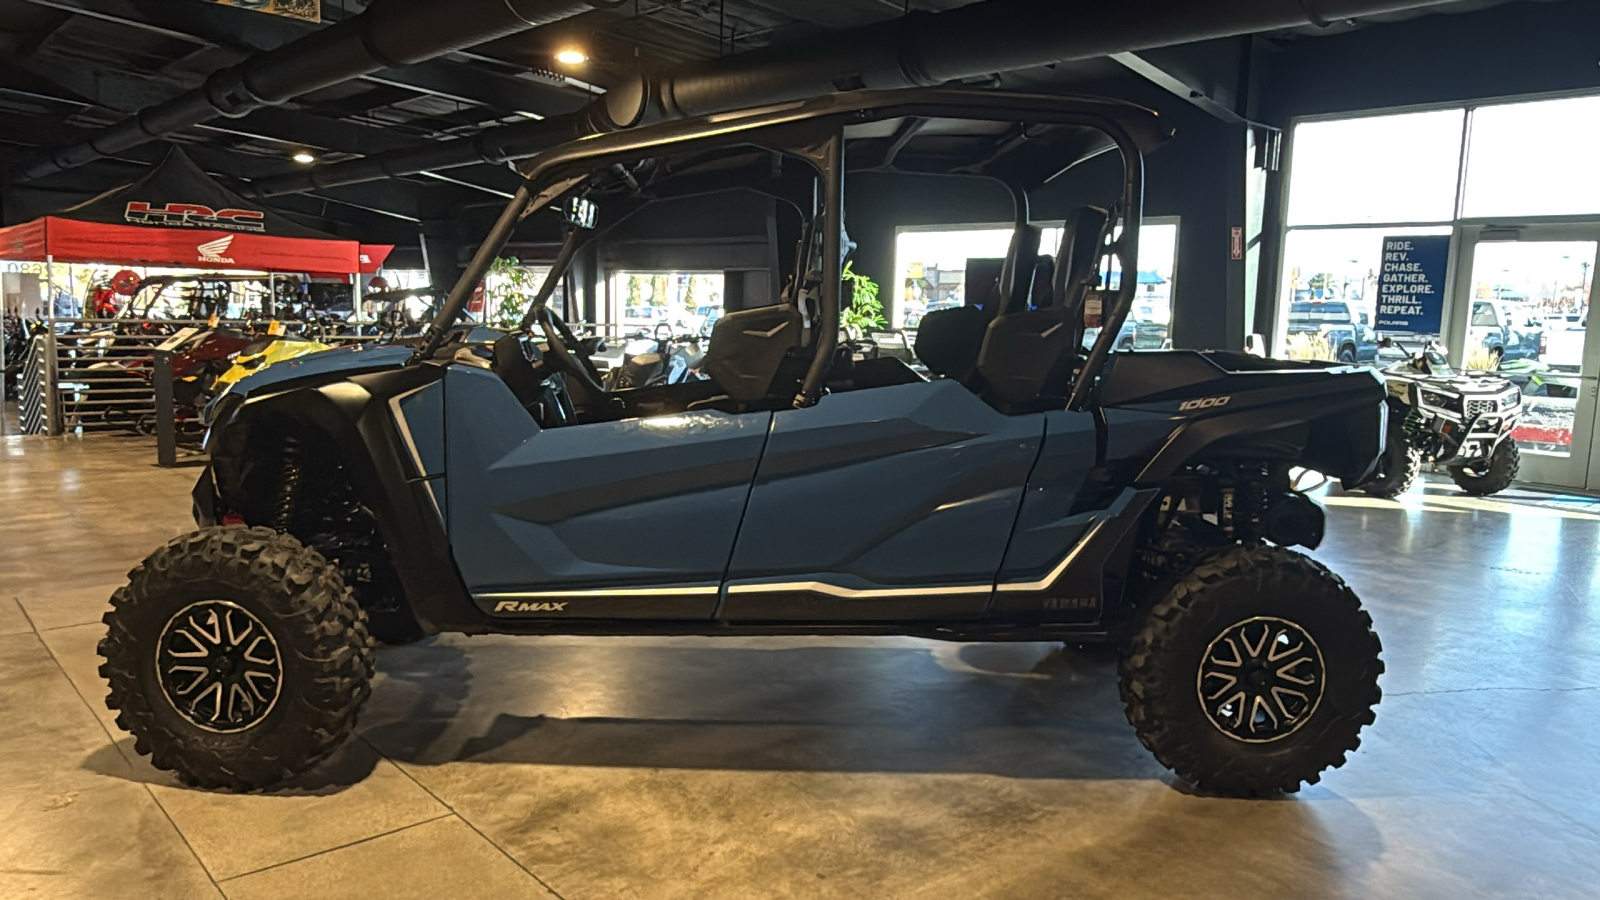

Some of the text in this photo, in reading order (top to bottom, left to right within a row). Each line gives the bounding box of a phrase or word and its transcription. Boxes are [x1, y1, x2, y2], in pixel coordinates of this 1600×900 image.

[124, 201, 264, 229] HRC
[1386, 241, 1414, 251] RIDE.
[198, 255, 235, 264] HONDA
[1385, 252, 1409, 262] REV.
[1384, 262, 1423, 272] CHASE.
[1383, 273, 1428, 283] GATHER.
[1382, 284, 1434, 294] EXPLORE.
[1381, 294, 1422, 304] THRILL.
[1379, 305, 1423, 315] REPEAT.
[1179, 396, 1231, 410] 1000
[494, 601, 569, 612] RMAX
